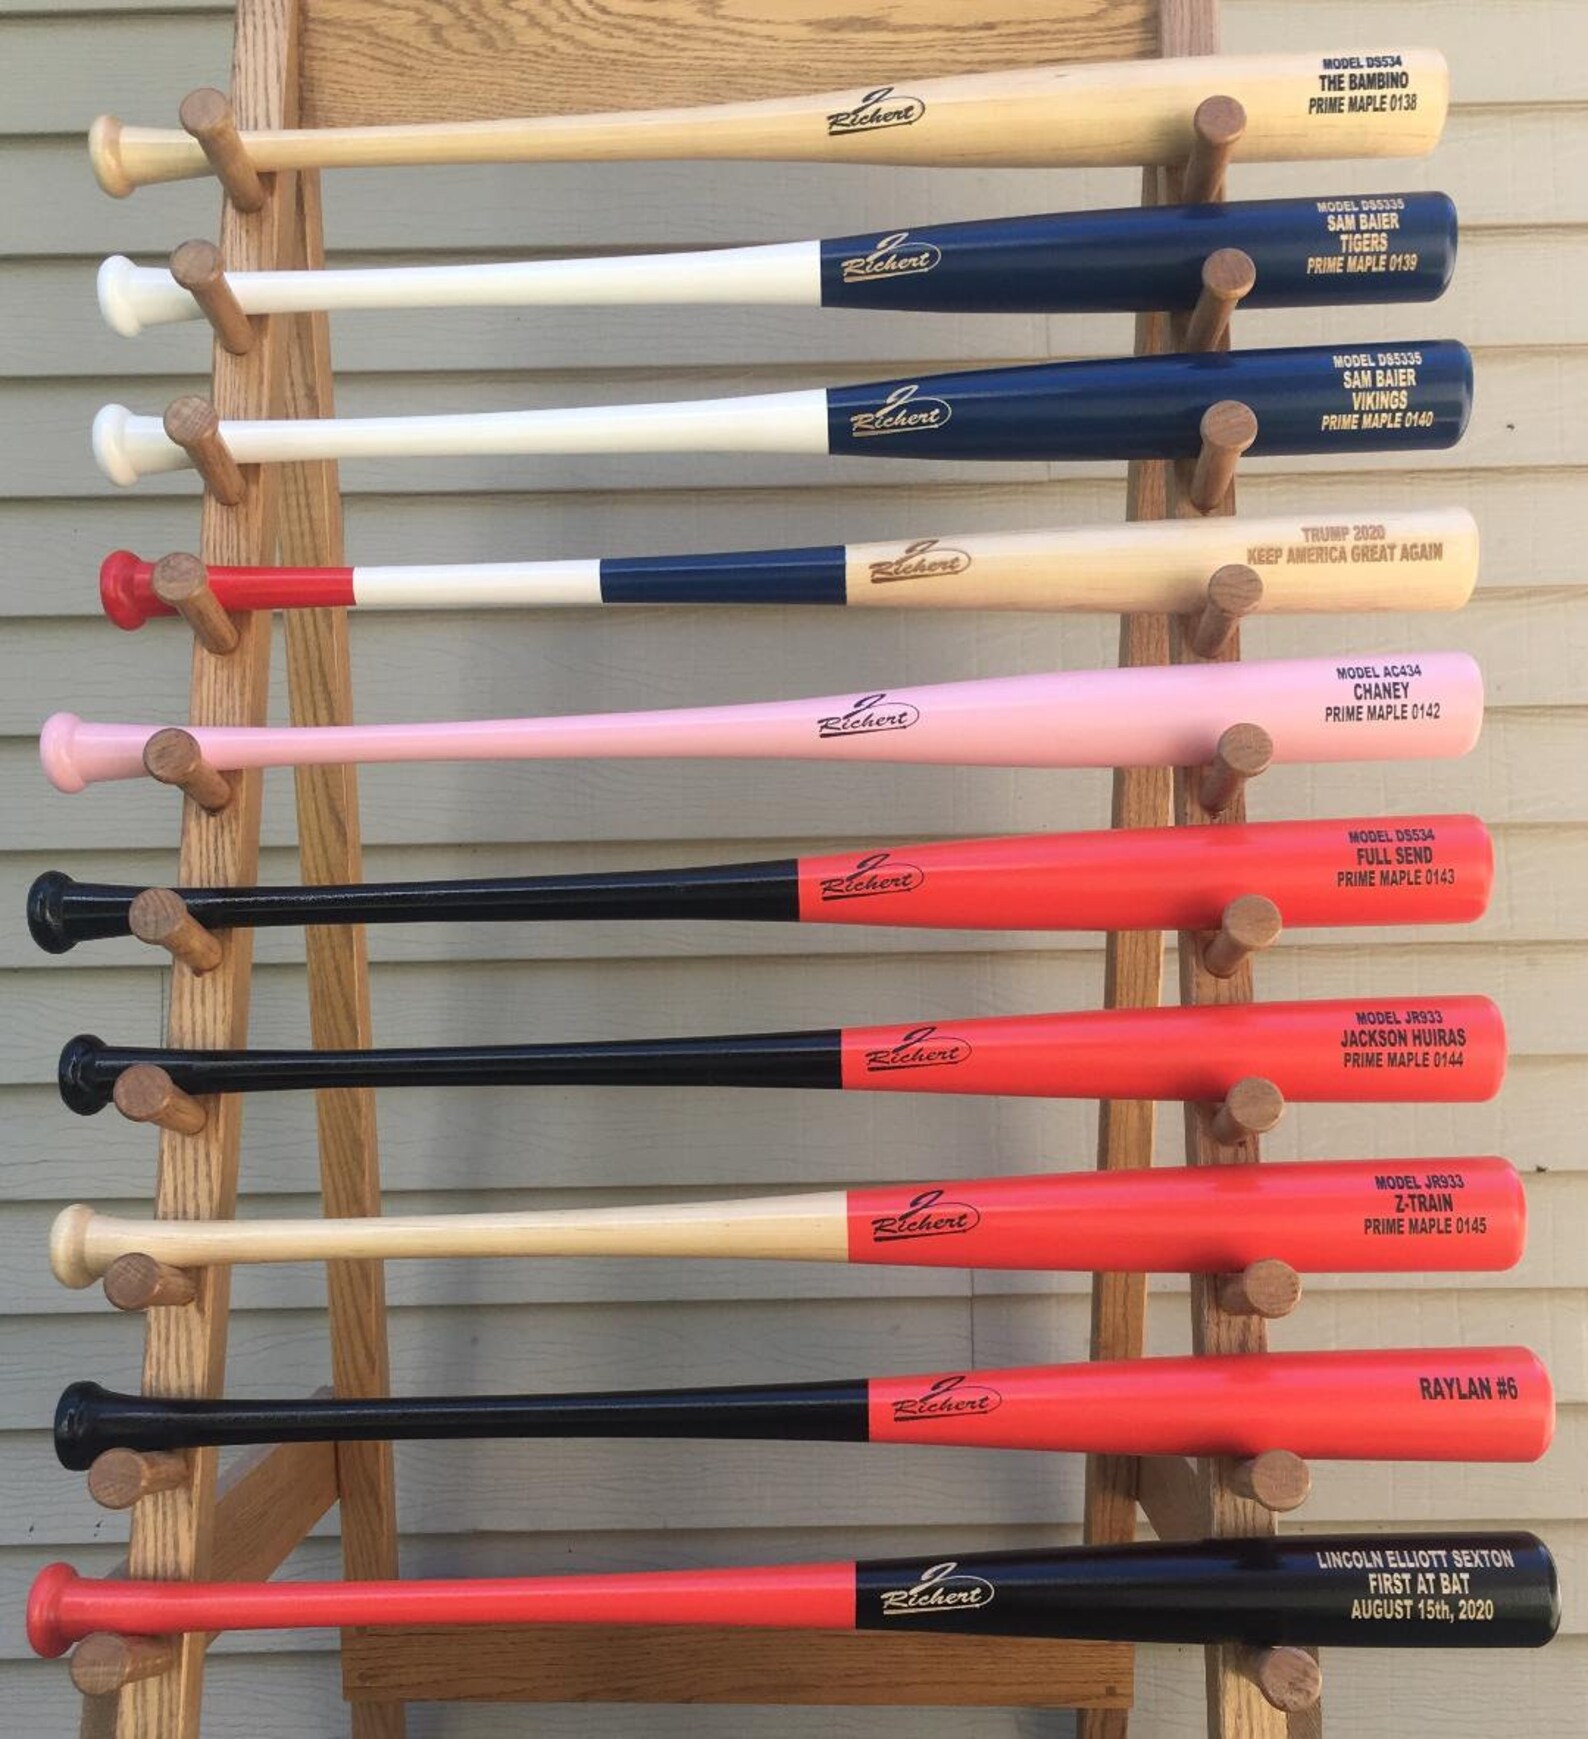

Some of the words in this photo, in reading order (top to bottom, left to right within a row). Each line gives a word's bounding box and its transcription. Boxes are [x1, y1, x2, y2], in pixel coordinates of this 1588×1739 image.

[1323, 58, 1364, 69] MODEL
[1366, 56, 1402, 68] DS534
[1319, 74, 1345, 91] THE
[1350, 72, 1409, 90] BAMBINO
[1309, 97, 1344, 114] PRIME
[1349, 95, 1387, 112] MAPLE
[1389, 94, 1417, 111] 0138
[826, 106, 915, 130] Richert
[1317, 201, 1358, 212] MODEL
[1327, 215, 1356, 231] SAM
[1360, 213, 1399, 230] BAIER
[1340, 233, 1388, 253] TIGERS
[841, 252, 930, 276] Richert
[1307, 257, 1343, 274] PRIME
[1347, 255, 1385, 273] MAPLE
[1389, 254, 1418, 271] 0139
[1333, 354, 1375, 368] MODEL
[1343, 371, 1372, 389] SAM
[1376, 369, 1416, 387] BAIER
[1353, 391, 1408, 410] VIKINGS
[851, 407, 941, 431] Richert
[1322, 414, 1358, 431] PRIME
[1362, 413, 1402, 429] MAPLE
[1405, 411, 1434, 428] 0140
[1301, 526, 1350, 542] TRUMP
[1353, 525, 1385, 540] 2020
[1247, 548, 1282, 565] KEEP
[1287, 547, 1347, 564] AMERICA
[1351, 544, 1396, 562] GREAT
[1400, 543, 1443, 561] AGAIN
[869, 555, 962, 579] Richert
[1337, 666, 1380, 679] MODEL
[1383, 664, 1422, 678] AC434
[1354, 682, 1410, 700] CHANEY
[817, 711, 908, 732] Richert
[1325, 706, 1363, 722] PRIME
[1367, 704, 1408, 721] MAPLE
[1412, 703, 1440, 719] 0142
[1348, 830, 1392, 843] MODEL
[1396, 828, 1434, 842] DS534
[1357, 848, 1392, 865] FULL
[1396, 846, 1433, 864] SEND
[820, 873, 912, 896] Richert
[1337, 871, 1375, 887] PRIME
[1379, 870, 1422, 886] MAPLE
[1426, 869, 1455, 885] 0143
[1356, 1012, 1400, 1024] MODEL
[1405, 1011, 1443, 1024] JR933
[1341, 1030, 1408, 1048] JACKSON
[1412, 1028, 1466, 1047] HUIRAS
[865, 1047, 960, 1065] Richert
[1344, 1053, 1383, 1068] PRIME
[1387, 1052, 1429, 1068] MAPLE
[1434, 1051, 1464, 1067] 0144
[1375, 1176, 1420, 1189] MODEL
[1425, 1174, 1464, 1188] JR933
[1395, 1193, 1453, 1213] Z-TRAIN
[871, 1213, 967, 1235] Richert
[1364, 1218, 1404, 1235] PRIME
[1408, 1218, 1452, 1234] MAPLE
[1456, 1217, 1486, 1233] 0145
[1420, 1377, 1492, 1400] RAYLAN
[1497, 1377, 1518, 1399] #6
[892, 1395, 989, 1415] Richert
[1316, 1552, 1384, 1569] LINCOLN
[1388, 1551, 1448, 1568] ELLIOTT
[1452, 1550, 1515, 1568] SEXTON
[1369, 1574, 1412, 1594] FIRST
[1417, 1573, 1436, 1593] AT
[1441, 1573, 1469, 1594] BAT
[880, 1587, 982, 1609] Richert
[1351, 1601, 1413, 1620] AUGUST
[1459, 1600, 1493, 1620] 2020
